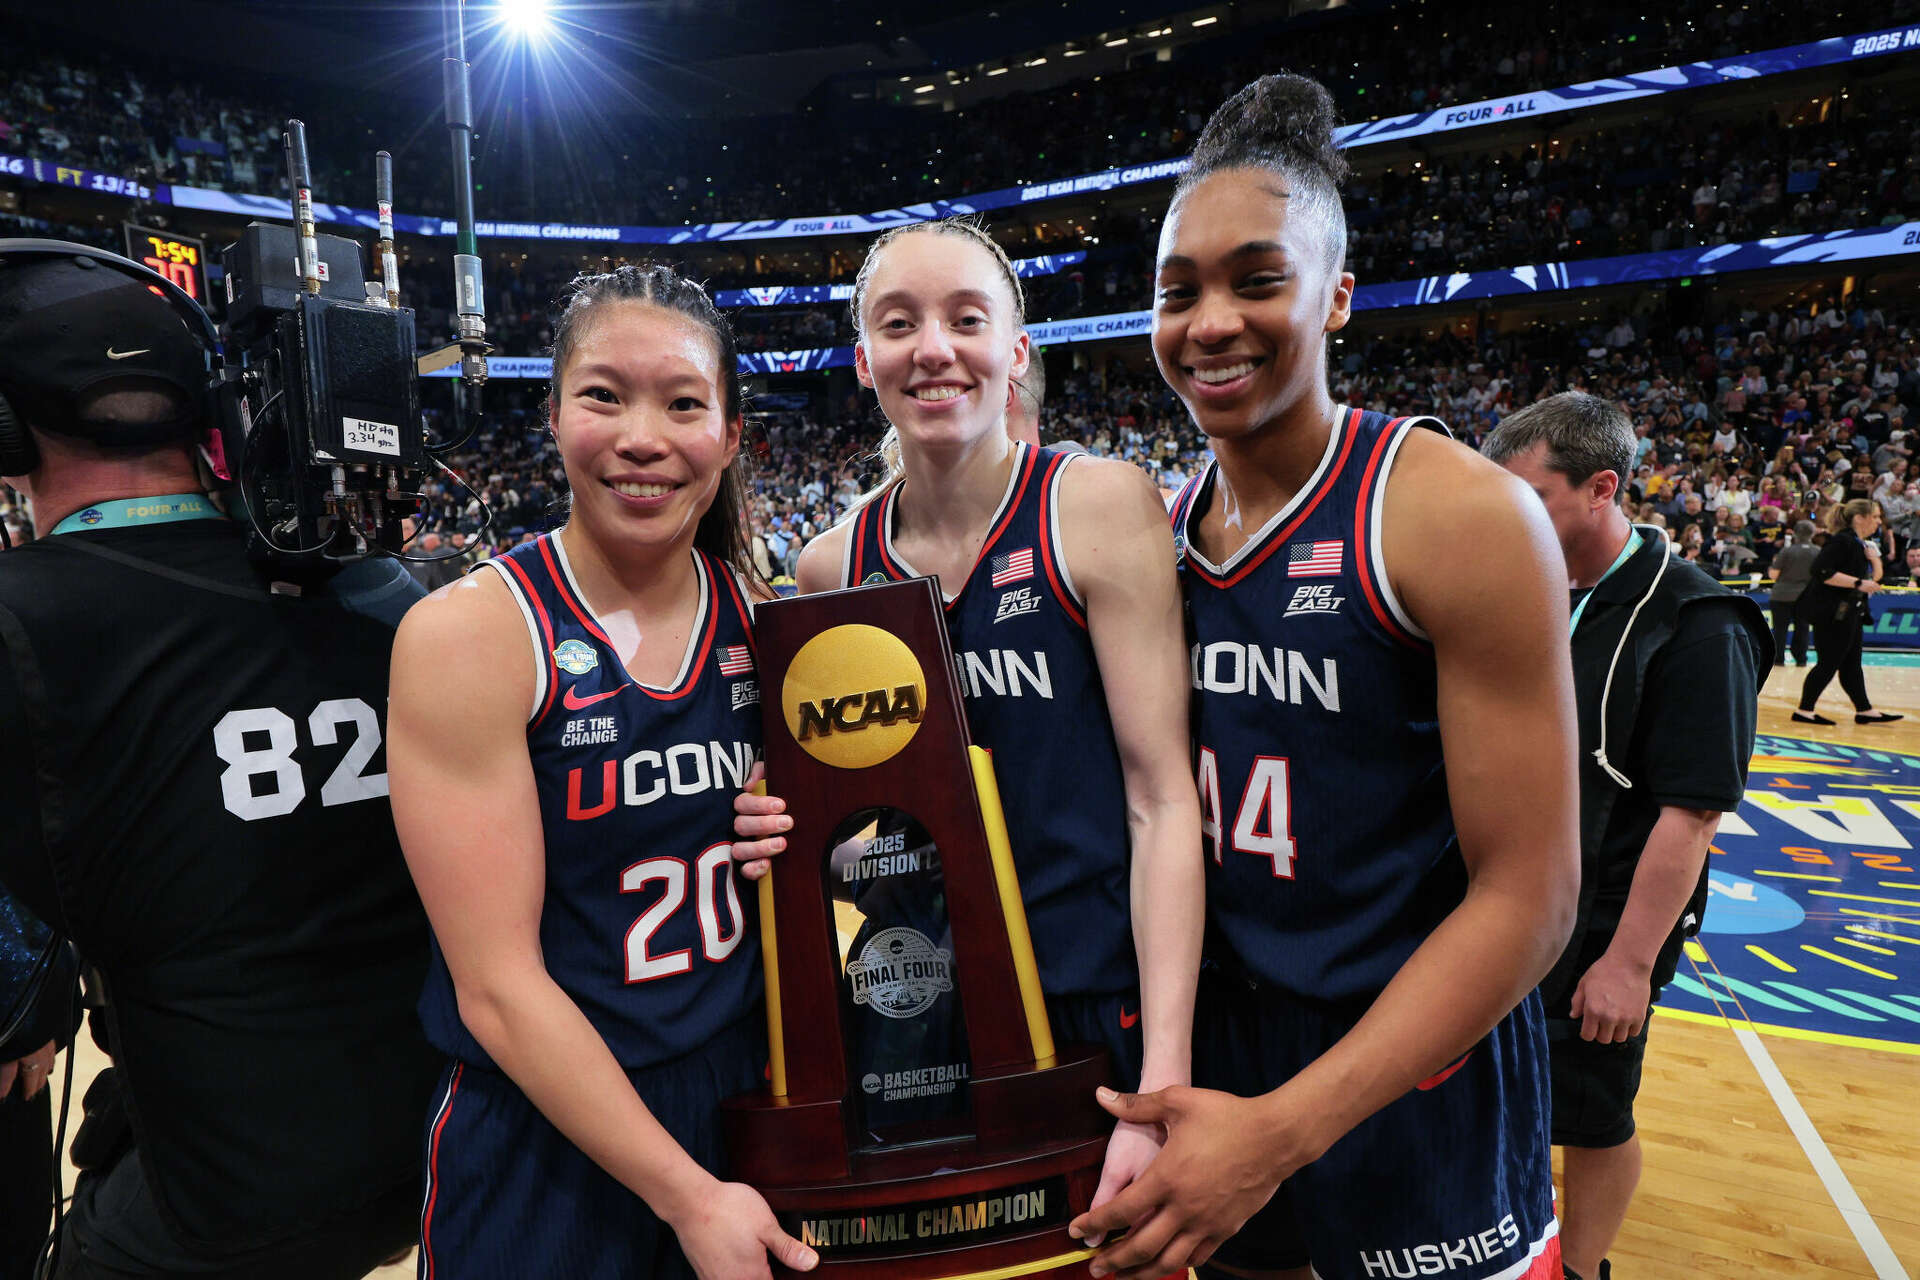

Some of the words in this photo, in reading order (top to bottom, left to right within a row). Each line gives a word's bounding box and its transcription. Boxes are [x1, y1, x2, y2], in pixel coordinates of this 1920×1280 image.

[1852, 32, 1902, 55] 2025
[1445, 107, 1493, 126] FOUR
[1502, 99, 1536, 116] ALL
[56, 167, 83, 186] FT
[1121, 159, 1190, 184] CHAMPIO
[542, 226, 621, 241] CHAMPIONS
[793, 223, 826, 233] FOUR
[831, 221, 853, 231] ALL
[147, 236, 198, 266] 7:54
[1096, 317, 1153, 333] CHAMPI
[492, 363, 553, 373] CHAMPIO
[358, 421, 377, 432] HD
[348, 431, 375, 444] 3.34
[1000, 587, 1031, 605] BIG
[1295, 585, 1334, 599] BIG
[997, 596, 1042, 617] EAST
[1287, 597, 1346, 611] EAST
[731, 680, 754, 694] BIG
[798, 683, 925, 742] NCAA
[565, 719, 586, 733] BE
[589, 716, 615, 731] THE
[561, 729, 618, 748] CHANGE
[213, 697, 390, 822] 82
[863, 834, 905, 856] 2025
[843, 852, 920, 883] DIVISION
[619, 840, 747, 985] 20
[854, 965, 899, 991] FINAL
[903, 961, 947, 980] FOUR
[884, 1063, 969, 1090] BASKETBALL
[883, 1081, 956, 1102] CHAMPIONSHIP
[801, 1214, 910, 1247] NATIONAL
[916, 1189, 1046, 1238] CHAMPION
[1359, 1213, 1521, 1279] HUSKIES
